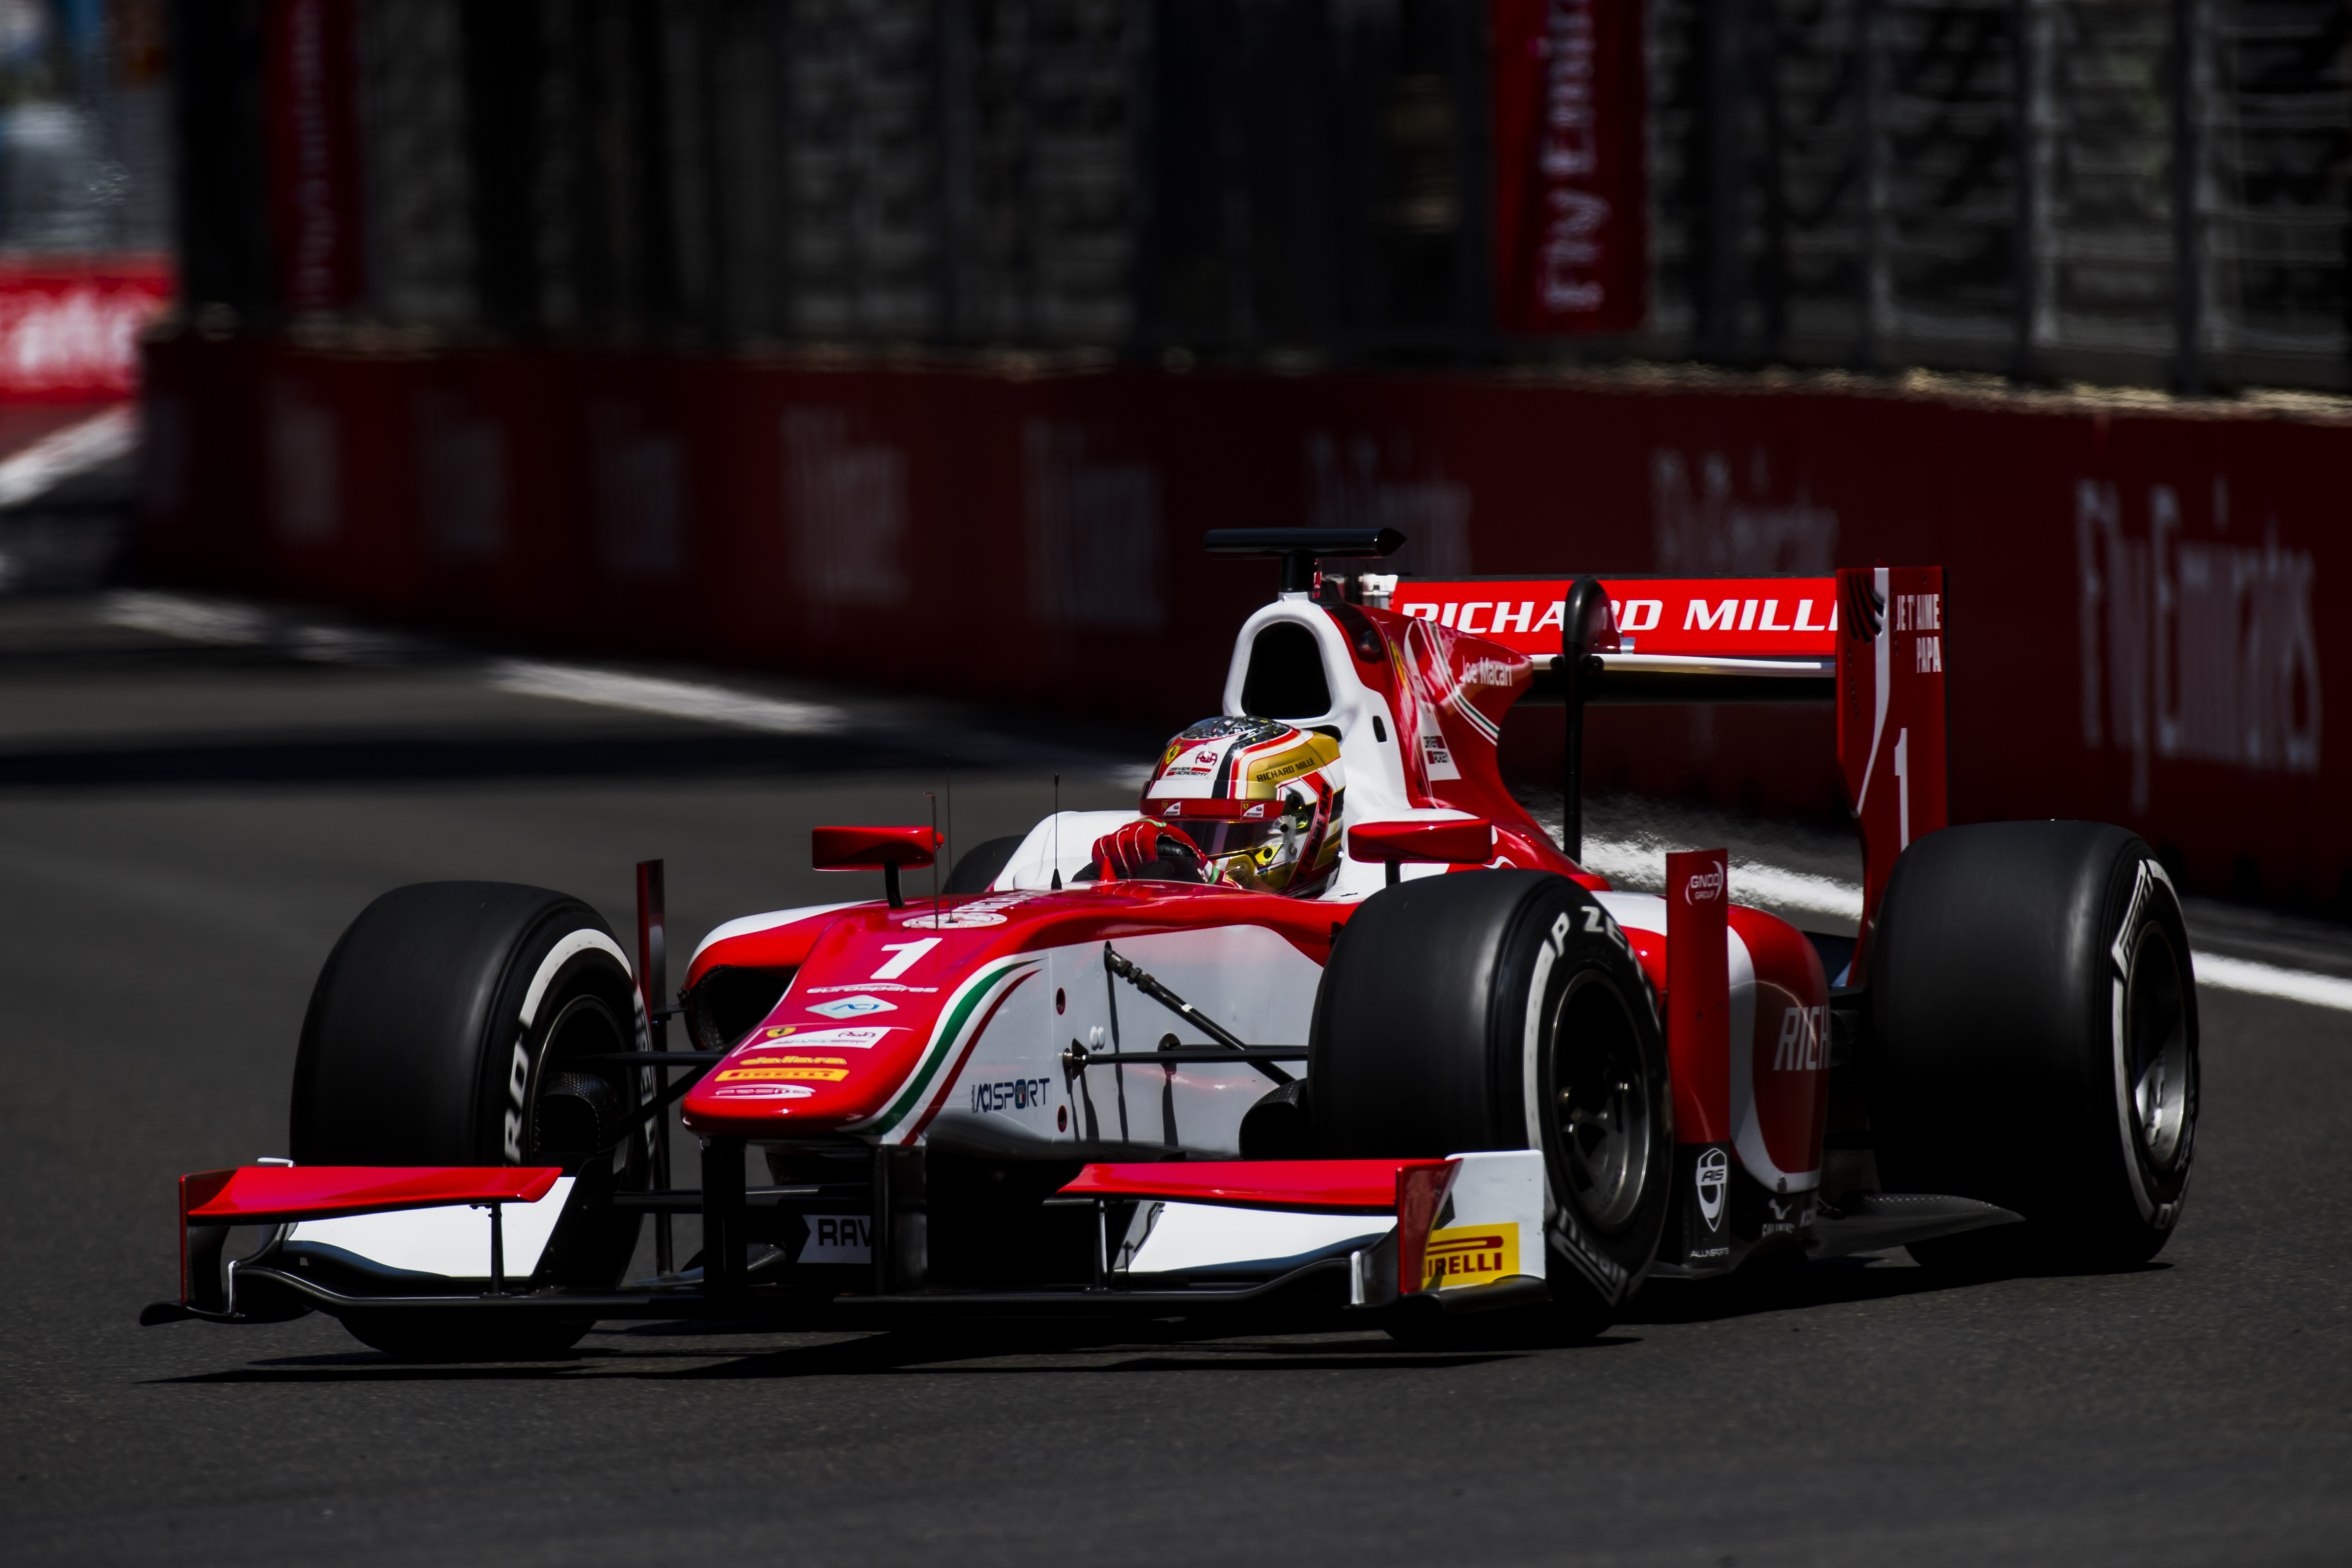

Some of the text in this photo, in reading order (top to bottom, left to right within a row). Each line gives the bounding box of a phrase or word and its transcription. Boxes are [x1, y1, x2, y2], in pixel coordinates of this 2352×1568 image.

[1683, 600, 1838, 631] MILL
[1461, 655, 1513, 686] Joe Macari
[1916, 637, 1943, 673] PAPA
[1256, 758, 1315, 782] RICHARD MILLE
[1894, 728, 1909, 853] 1
[870, 937, 943, 979] 1
[739, 1056, 847, 1066] dallara
